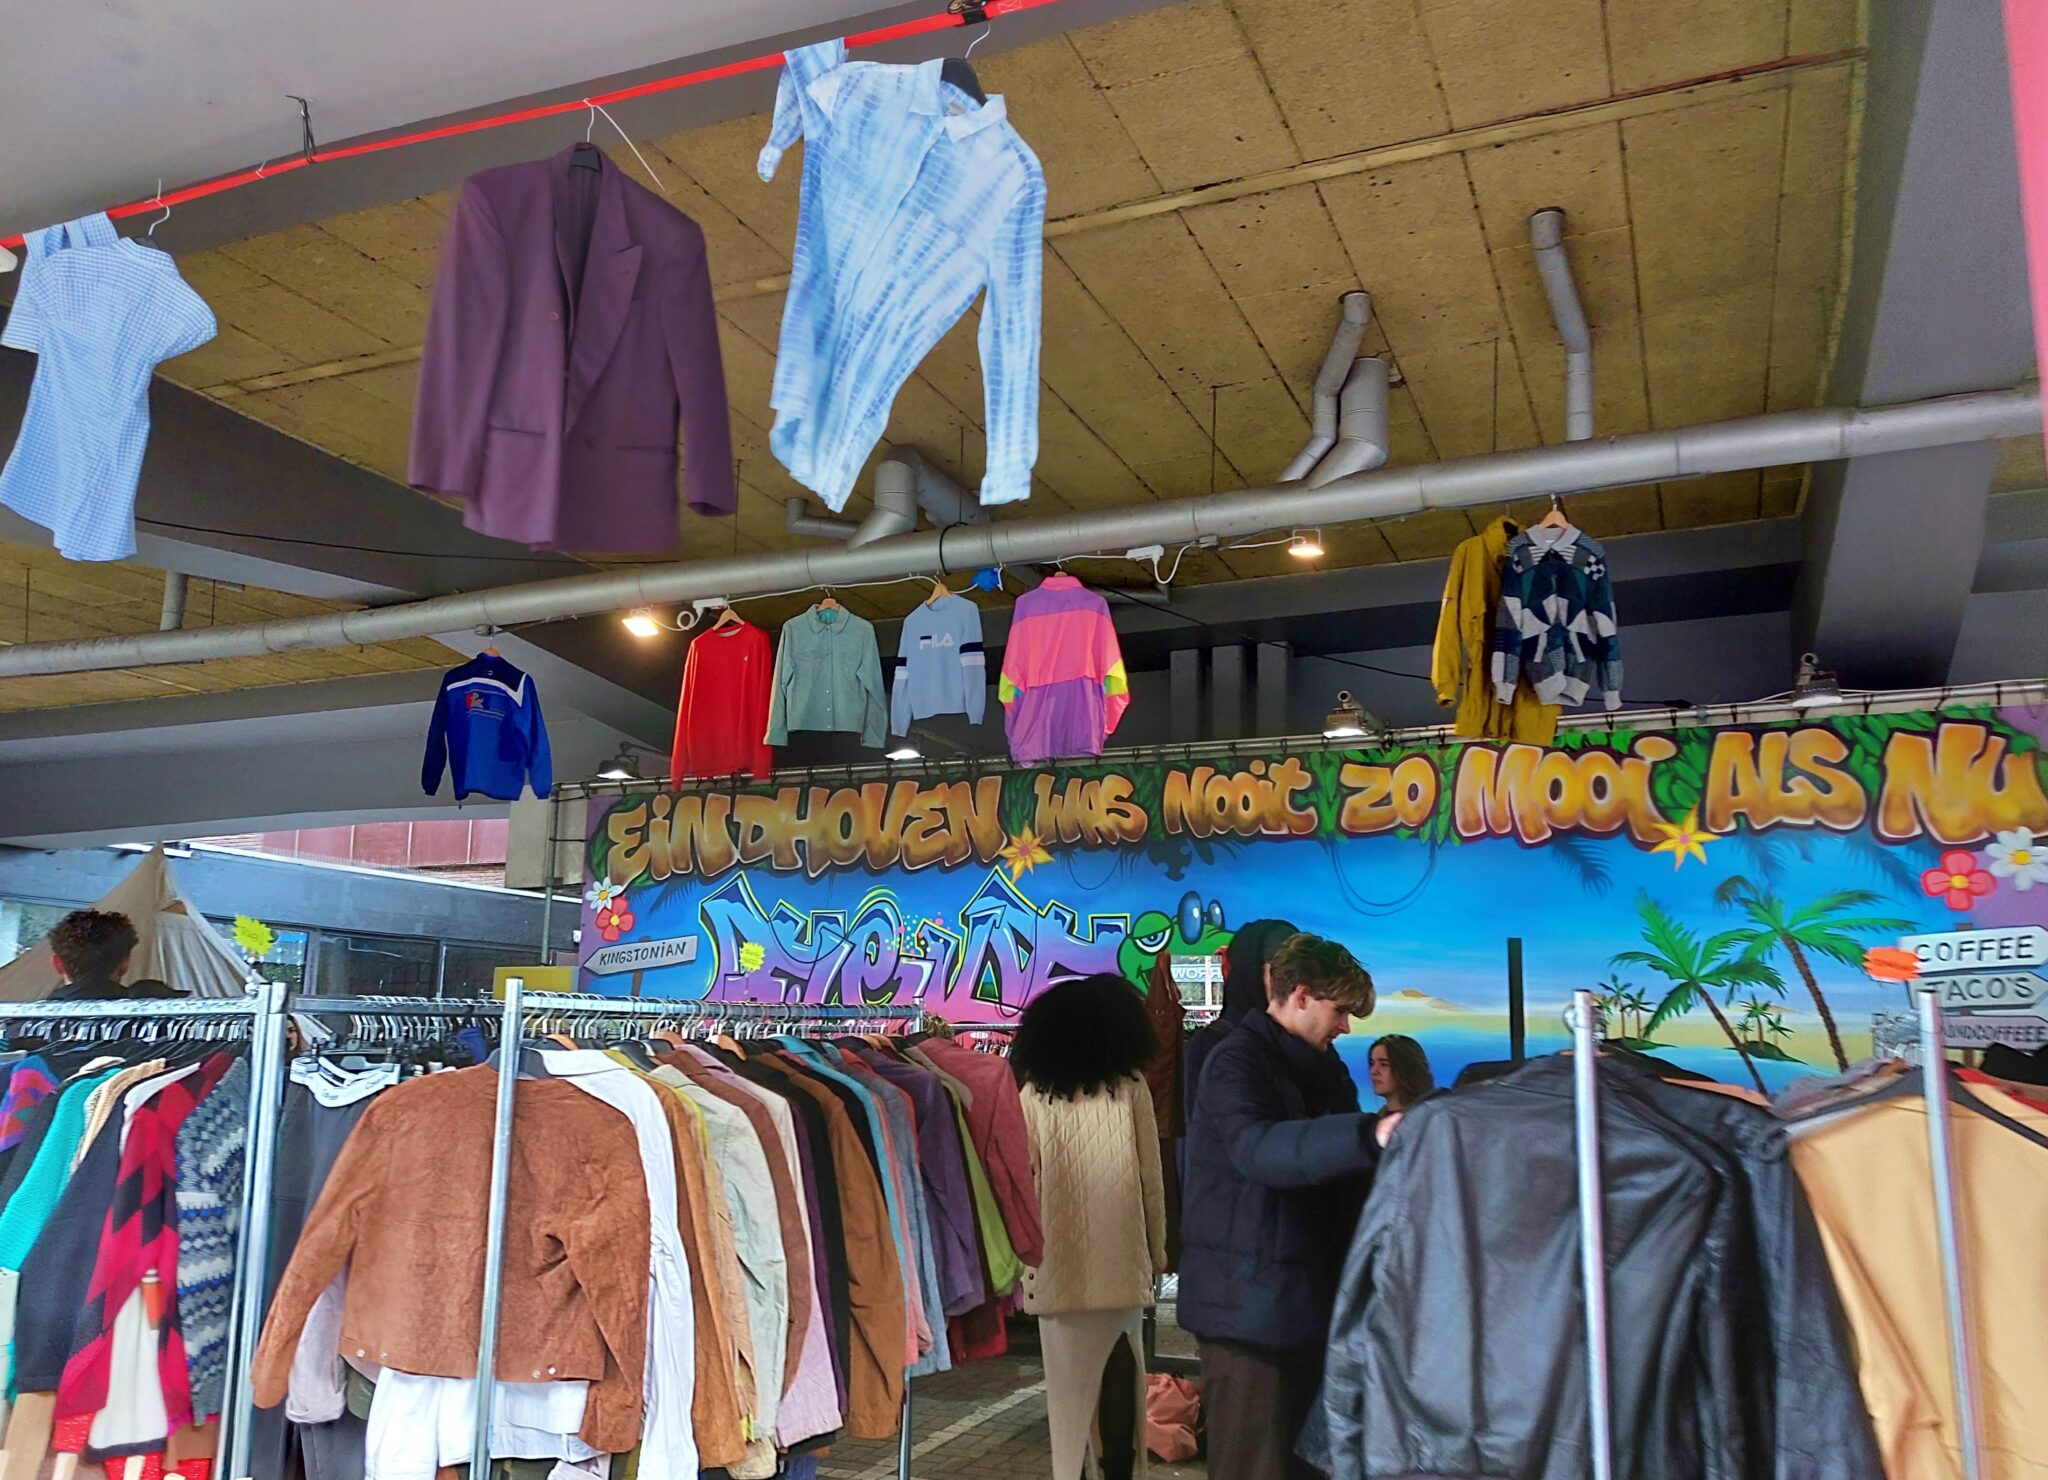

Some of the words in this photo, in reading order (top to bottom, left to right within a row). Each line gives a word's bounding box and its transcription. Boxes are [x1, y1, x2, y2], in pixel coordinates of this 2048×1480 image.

[920, 632, 956, 650] FILA
[1034, 773, 1149, 845] WAS
[1706, 728, 1867, 833] ALS
[1914, 934, 2035, 963] COFFEE
